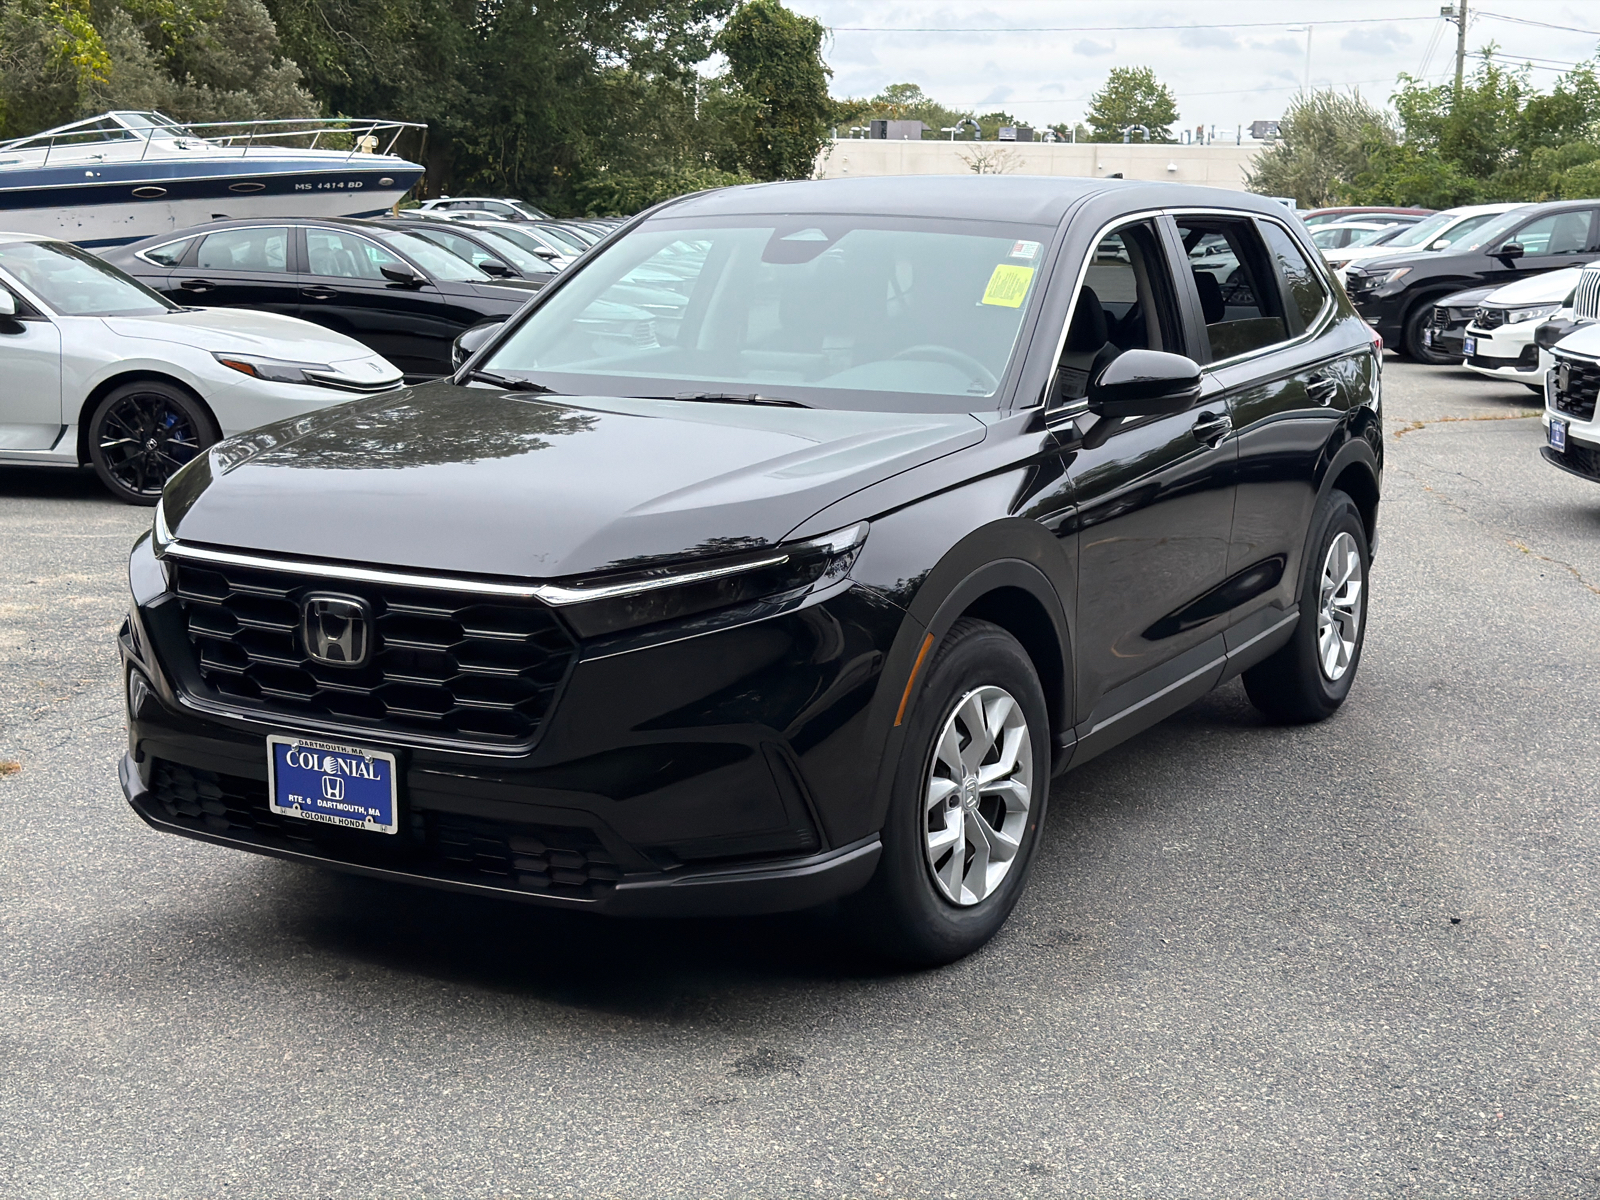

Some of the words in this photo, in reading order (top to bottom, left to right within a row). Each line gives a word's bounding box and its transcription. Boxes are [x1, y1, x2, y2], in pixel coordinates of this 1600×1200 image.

[298, 740, 350, 754] DARTMOUTH,
[351, 747, 364, 756] MA
[286, 750, 381, 780] COLONIAL
[288, 794, 305, 804] RTE.
[306, 797, 312, 805] 6
[317, 799, 367, 815] DARTMOUTH,
[368, 808, 381, 817] MA
[300, 811, 337, 824] COLONIAL
[338, 818, 366, 829] HONDA
